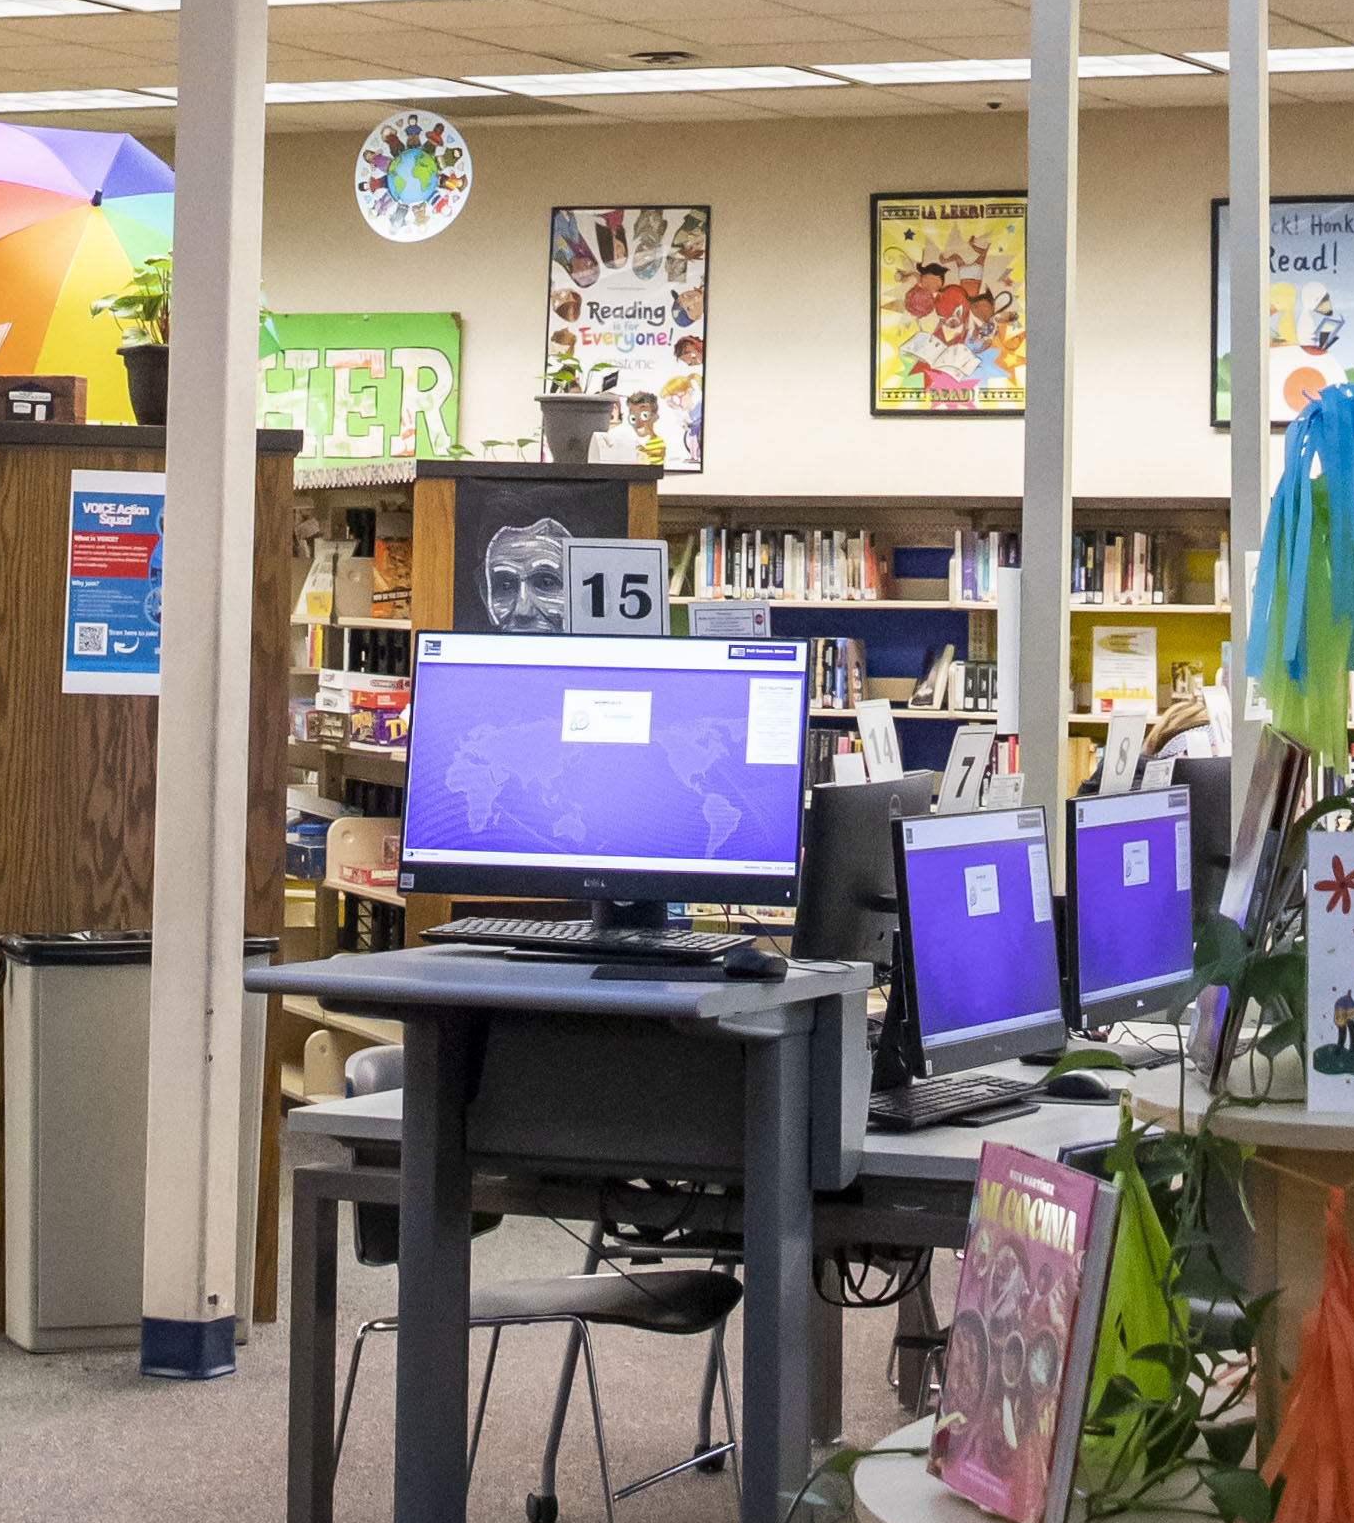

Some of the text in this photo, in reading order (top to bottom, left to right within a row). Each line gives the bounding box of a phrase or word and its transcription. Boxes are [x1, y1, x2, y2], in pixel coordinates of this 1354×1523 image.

[587, 301, 666, 327] Reading
[624, 322, 640, 331] for
[578, 327, 674, 354] Everyone!
[83, 502, 150, 516] VOICE Action
[99, 514, 133, 528] Squad
[582, 572, 653, 620] 15
[868, 726, 895, 764] 14
[1115, 737, 1131, 776] 8
[955, 756, 976, 798] 7
[1002, 1187, 1077, 1256] COCINA
